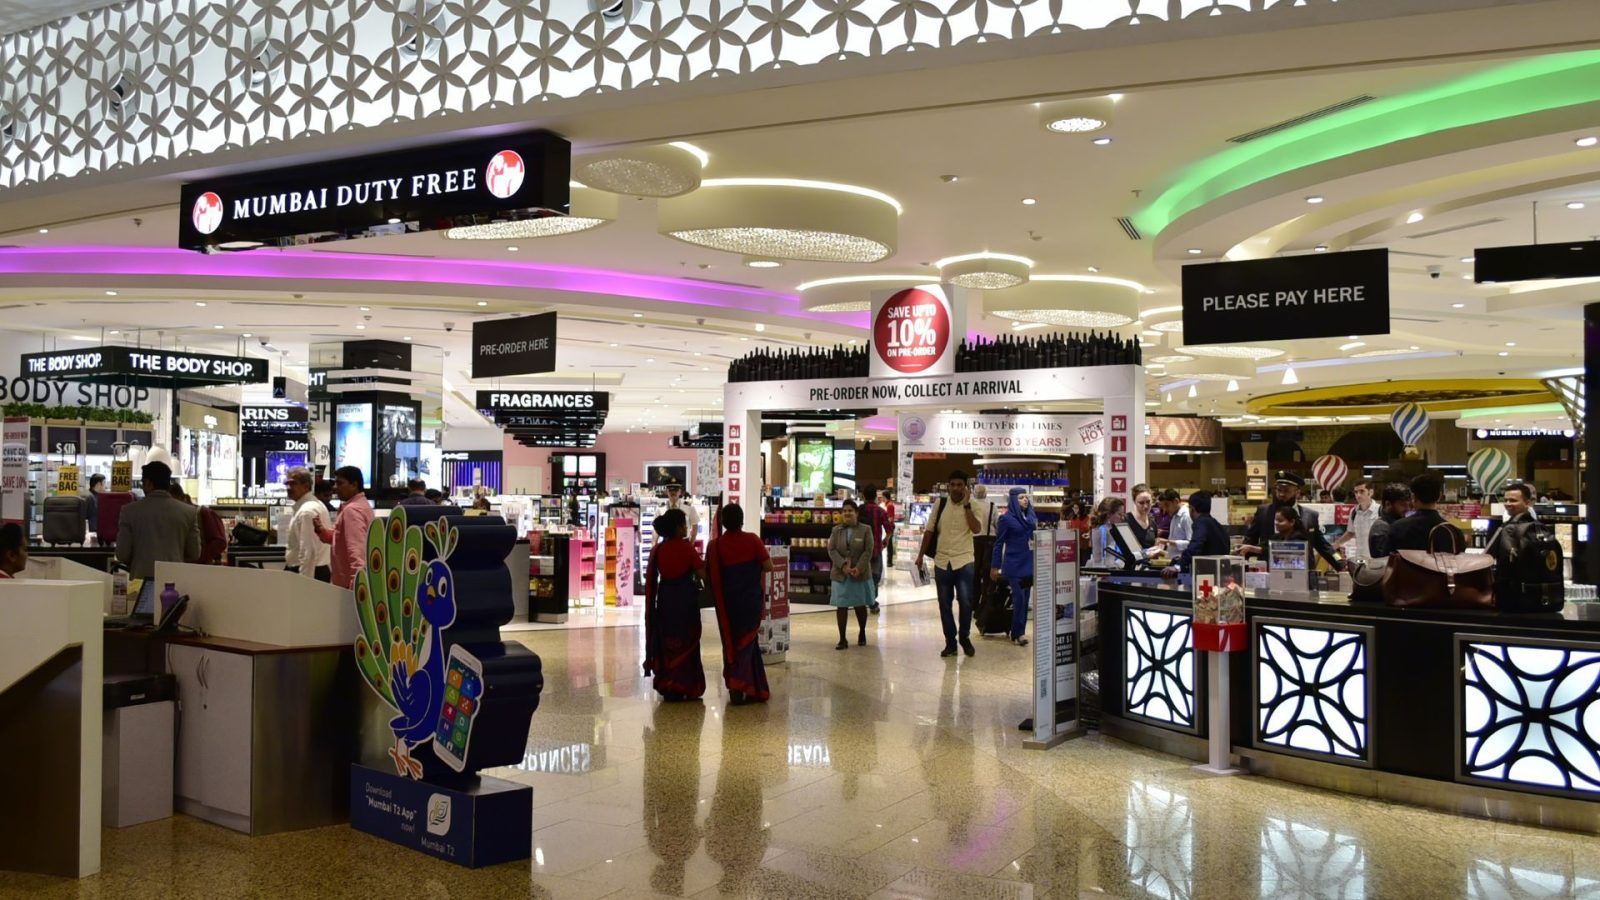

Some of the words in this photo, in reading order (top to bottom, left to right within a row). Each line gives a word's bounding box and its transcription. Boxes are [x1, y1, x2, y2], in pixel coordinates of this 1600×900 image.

[233, 188, 328, 219] MUMBAI
[336, 178, 402, 206] DUTY
[411, 168, 476, 197] FREE
[1203, 293, 1269, 311] PLEASE
[1275, 290, 1308, 306] PAY
[1314, 286, 1365, 304] HERE
[888, 306, 910, 318] SAVE
[887, 318, 937, 347] 10%
[480, 341, 527, 355] PRE-ORDER
[528, 338, 549, 351] HERE
[887, 348, 897, 357] ON
[898, 347, 936, 357] PRE-ORDER
[28, 358, 46, 372] THE
[48, 355, 74, 371] BODY
[129, 353, 161, 370] THE
[166, 356, 210, 373] BODY
[77, 383, 149, 408] SHOP
[809, 386, 868, 401] PRE-ORDER
[872, 385, 901, 400] NOW,
[904, 383, 952, 398] COLLECT
[955, 382, 970, 395] AT
[972, 380, 1023, 395] ARRIVAL
[490, 393, 594, 407] FRAGRANCES
[940, 437, 945, 446] 3
[949, 437, 994, 446] CHEERS
[998, 437, 1012, 446] TO
[1015, 437, 1021, 446] 3
[1025, 437, 1062, 446] YEARS
[59, 472, 78, 481] FREE
[112, 467, 130, 475] FREE
[58, 481, 78, 491] BAG
[112, 476, 130, 486] BAG
[365, 782, 392, 798] Download
[393, 804, 401, 815] T2
[421, 836, 446, 853] Mumbai
[447, 844, 455, 856] T2
